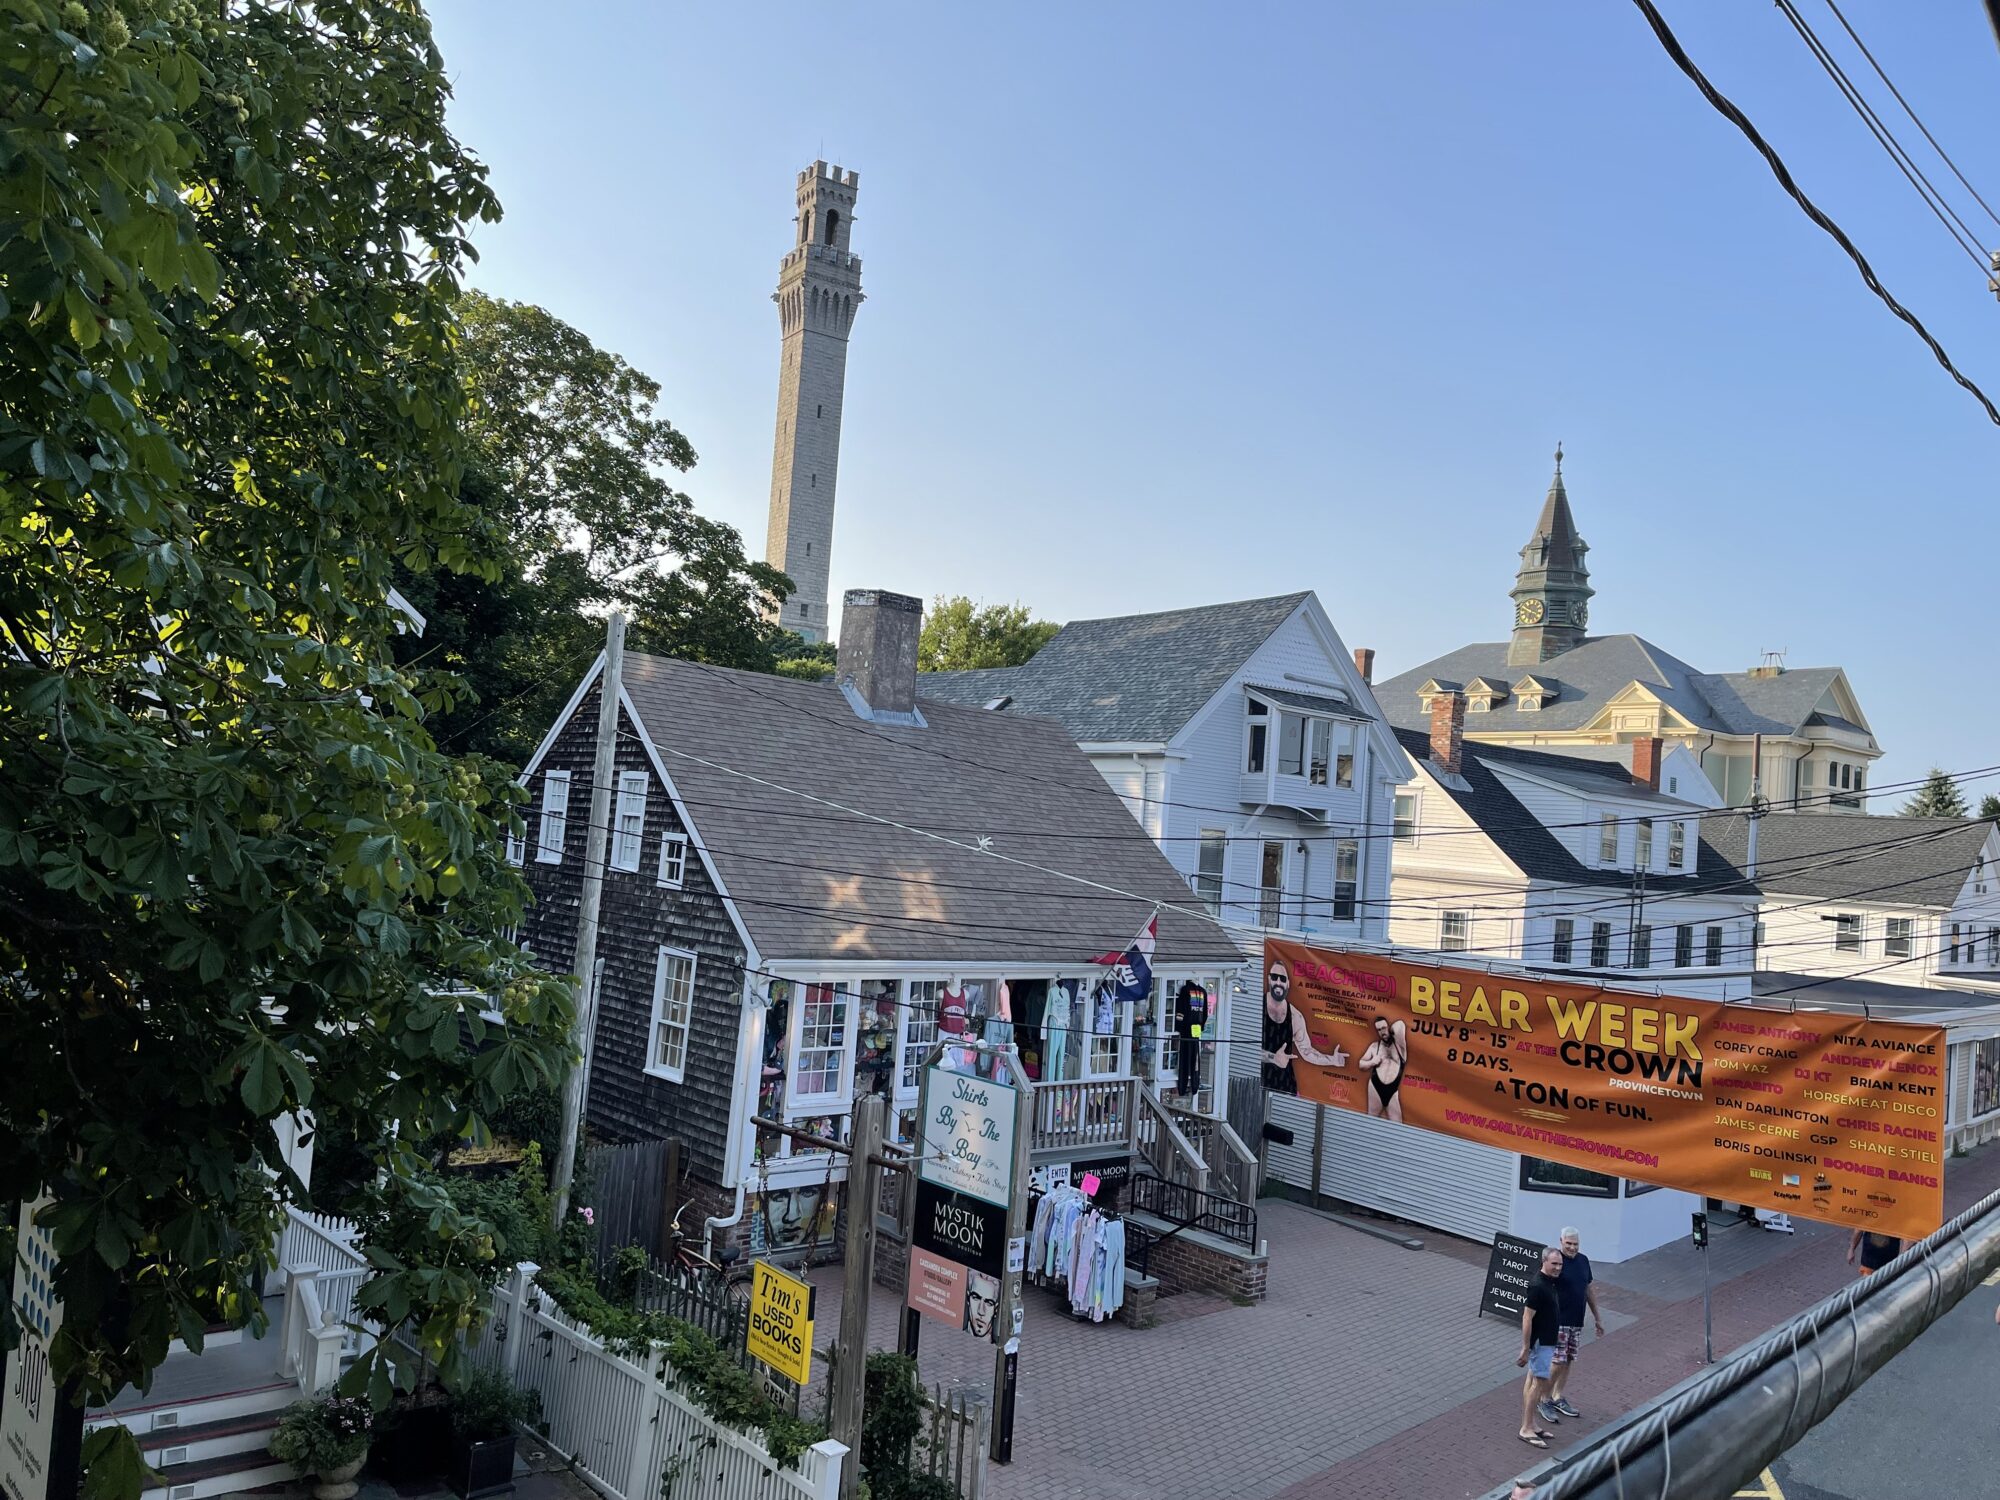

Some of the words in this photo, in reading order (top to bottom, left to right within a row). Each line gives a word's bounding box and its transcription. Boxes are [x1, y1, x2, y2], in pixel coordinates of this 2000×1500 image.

[1341, 989, 1366, 999] BEACH
[1368, 994, 1390, 1003] PARTY
[1410, 975, 1533, 1033] BEAR
[1545, 994, 1703, 1061] WEEK
[1712, 1020, 1755, 1035] JAMES
[1758, 1026, 1821, 1043] ANTHONY
[1411, 1020, 1454, 1039] JULY
[1516, 1041, 1532, 1052] AT
[1534, 1043, 1557, 1057] THE
[1560, 1040, 1703, 1088] CROWN
[1714, 1040, 1755, 1054] COREY
[1757, 1046, 1798, 1059] CRAIG
[1834, 1034, 1867, 1047] NITA
[1871, 1039, 1936, 1055] AVIANCE
[1447, 1048, 1457, 1062] 8
[1462, 1051, 1513, 1073] DAYS.
[1713, 1058, 1739, 1071] TOM
[1742, 1062, 1769, 1074] YAZ
[1821, 1052, 1885, 1070] ANDREW
[1888, 1061, 1938, 1077] LENOX
[1794, 1067, 1810, 1079] DJ
[1814, 1071, 1832, 1083] KT
[1850, 1076, 1893, 1091] BRIAN
[1898, 1082, 1936, 1097] KENT
[952, 1078, 989, 1107] Shirts
[1494, 1080, 1507, 1094] A
[1509, 1078, 1569, 1109] TON
[1573, 1096, 1599, 1111] OF
[1605, 1101, 1653, 1121] FUN.
[1608, 1077, 1703, 1101] PROVINCETOWN
[1715, 1096, 1742, 1109] DAN
[1746, 1102, 1829, 1125] DARLINGTON
[1803, 1089, 1888, 1110] HORSEMEAT
[1893, 1102, 1937, 1118] DISCO
[936, 1105, 958, 1135] By
[979, 1117, 1001, 1142] The
[1714, 1115, 1755, 1131] JAMES
[1759, 1123, 1800, 1139] CERNE
[1836, 1118, 1880, 1133] CHRIS
[1883, 1123, 1937, 1142] RACINE
[1445, 1109, 1659, 1168] WWW.ONLYATTHECROWN.COM
[1714, 1137, 1750, 1153] BORIS
[1753, 1145, 1817, 1165] DOLINSKI
[1810, 1134, 1838, 1146] GSP
[952, 1138, 981, 1170] Bay
[1849, 1139, 1896, 1156] SHANE
[1900, 1148, 1938, 1165] STIEL
[976, 1172, 990, 1186] Kids
[992, 1178, 1007, 1193] Stuff
[1051, 1167, 1068, 1179] ENTER
[1103, 1165, 1127, 1176] MOON
[1823, 1157, 1885, 1179] BOOMER
[1888, 1169, 1938, 1189] BANKS
[935, 1200, 984, 1232] MYSTIK
[934, 1216, 983, 1250] MOON
[1498, 1241, 1539, 1259] CRYSTALS
[1502, 1258, 1528, 1272] TAROT
[1494, 1271, 1529, 1289] INCENSE
[760, 1271, 801, 1315] Tim's
[1490, 1287, 1528, 1304] JEWELRY
[763, 1302, 793, 1329] USED
[752, 1313, 802, 1355] BOOKS
[763, 1381, 786, 1408] OPEN
